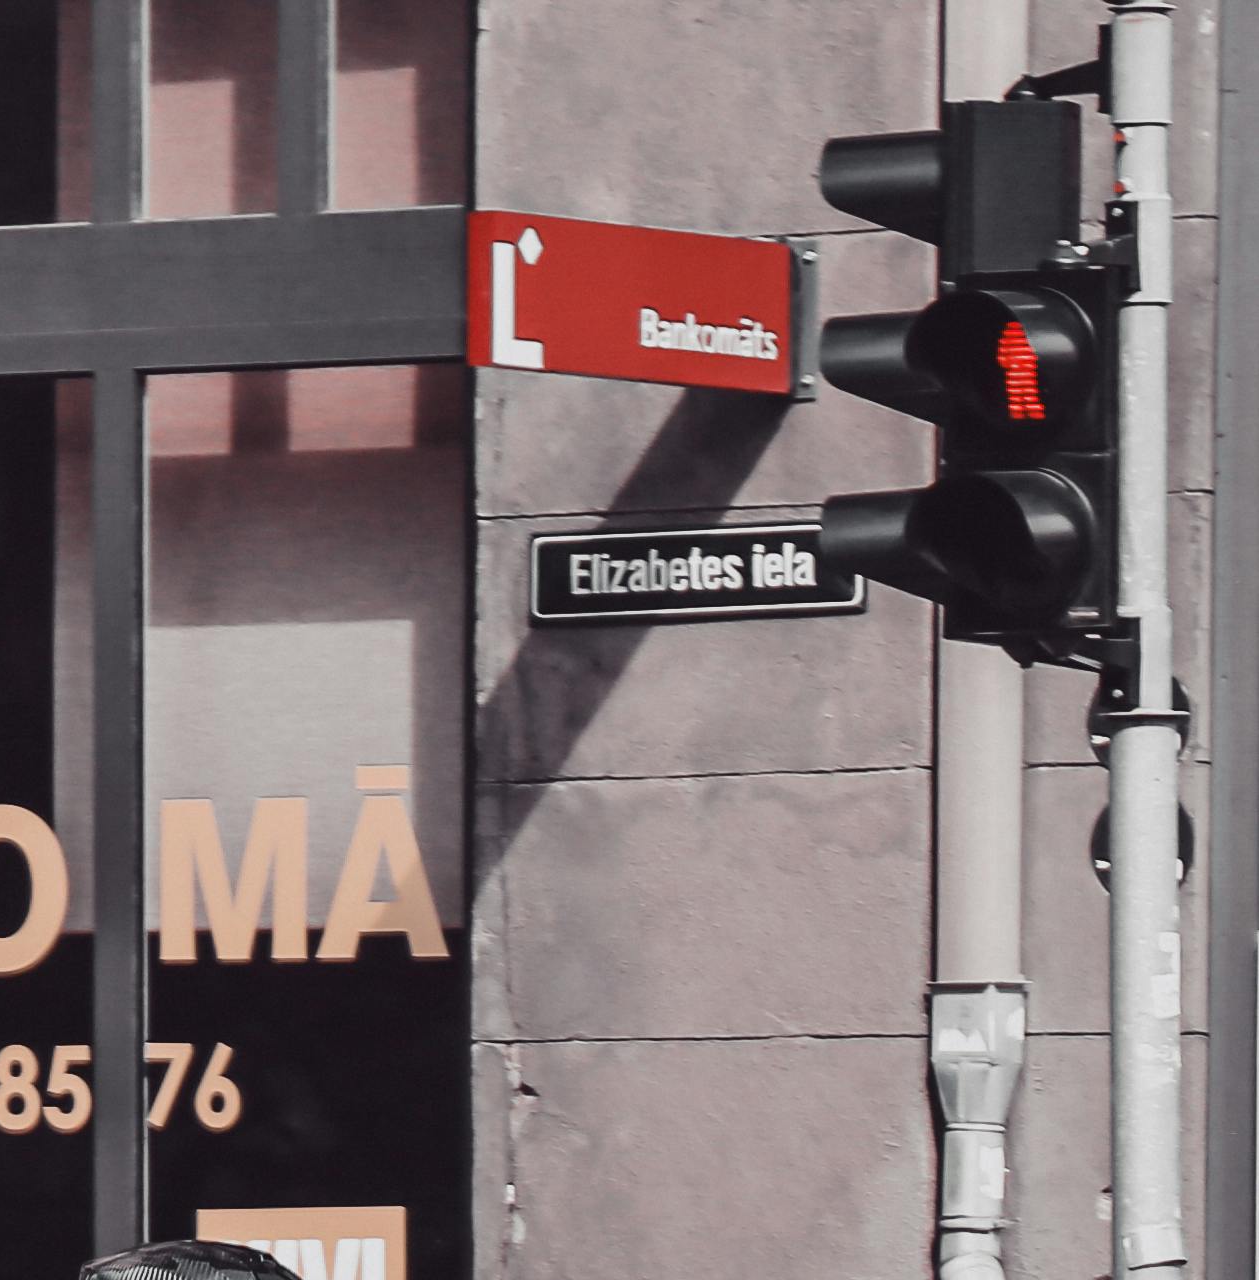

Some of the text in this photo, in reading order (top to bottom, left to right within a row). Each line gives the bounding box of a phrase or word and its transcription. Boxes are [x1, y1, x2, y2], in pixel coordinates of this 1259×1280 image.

[639, 307, 779, 360] Bankomāts
[570, 541, 817, 596] Elizabetes iela
